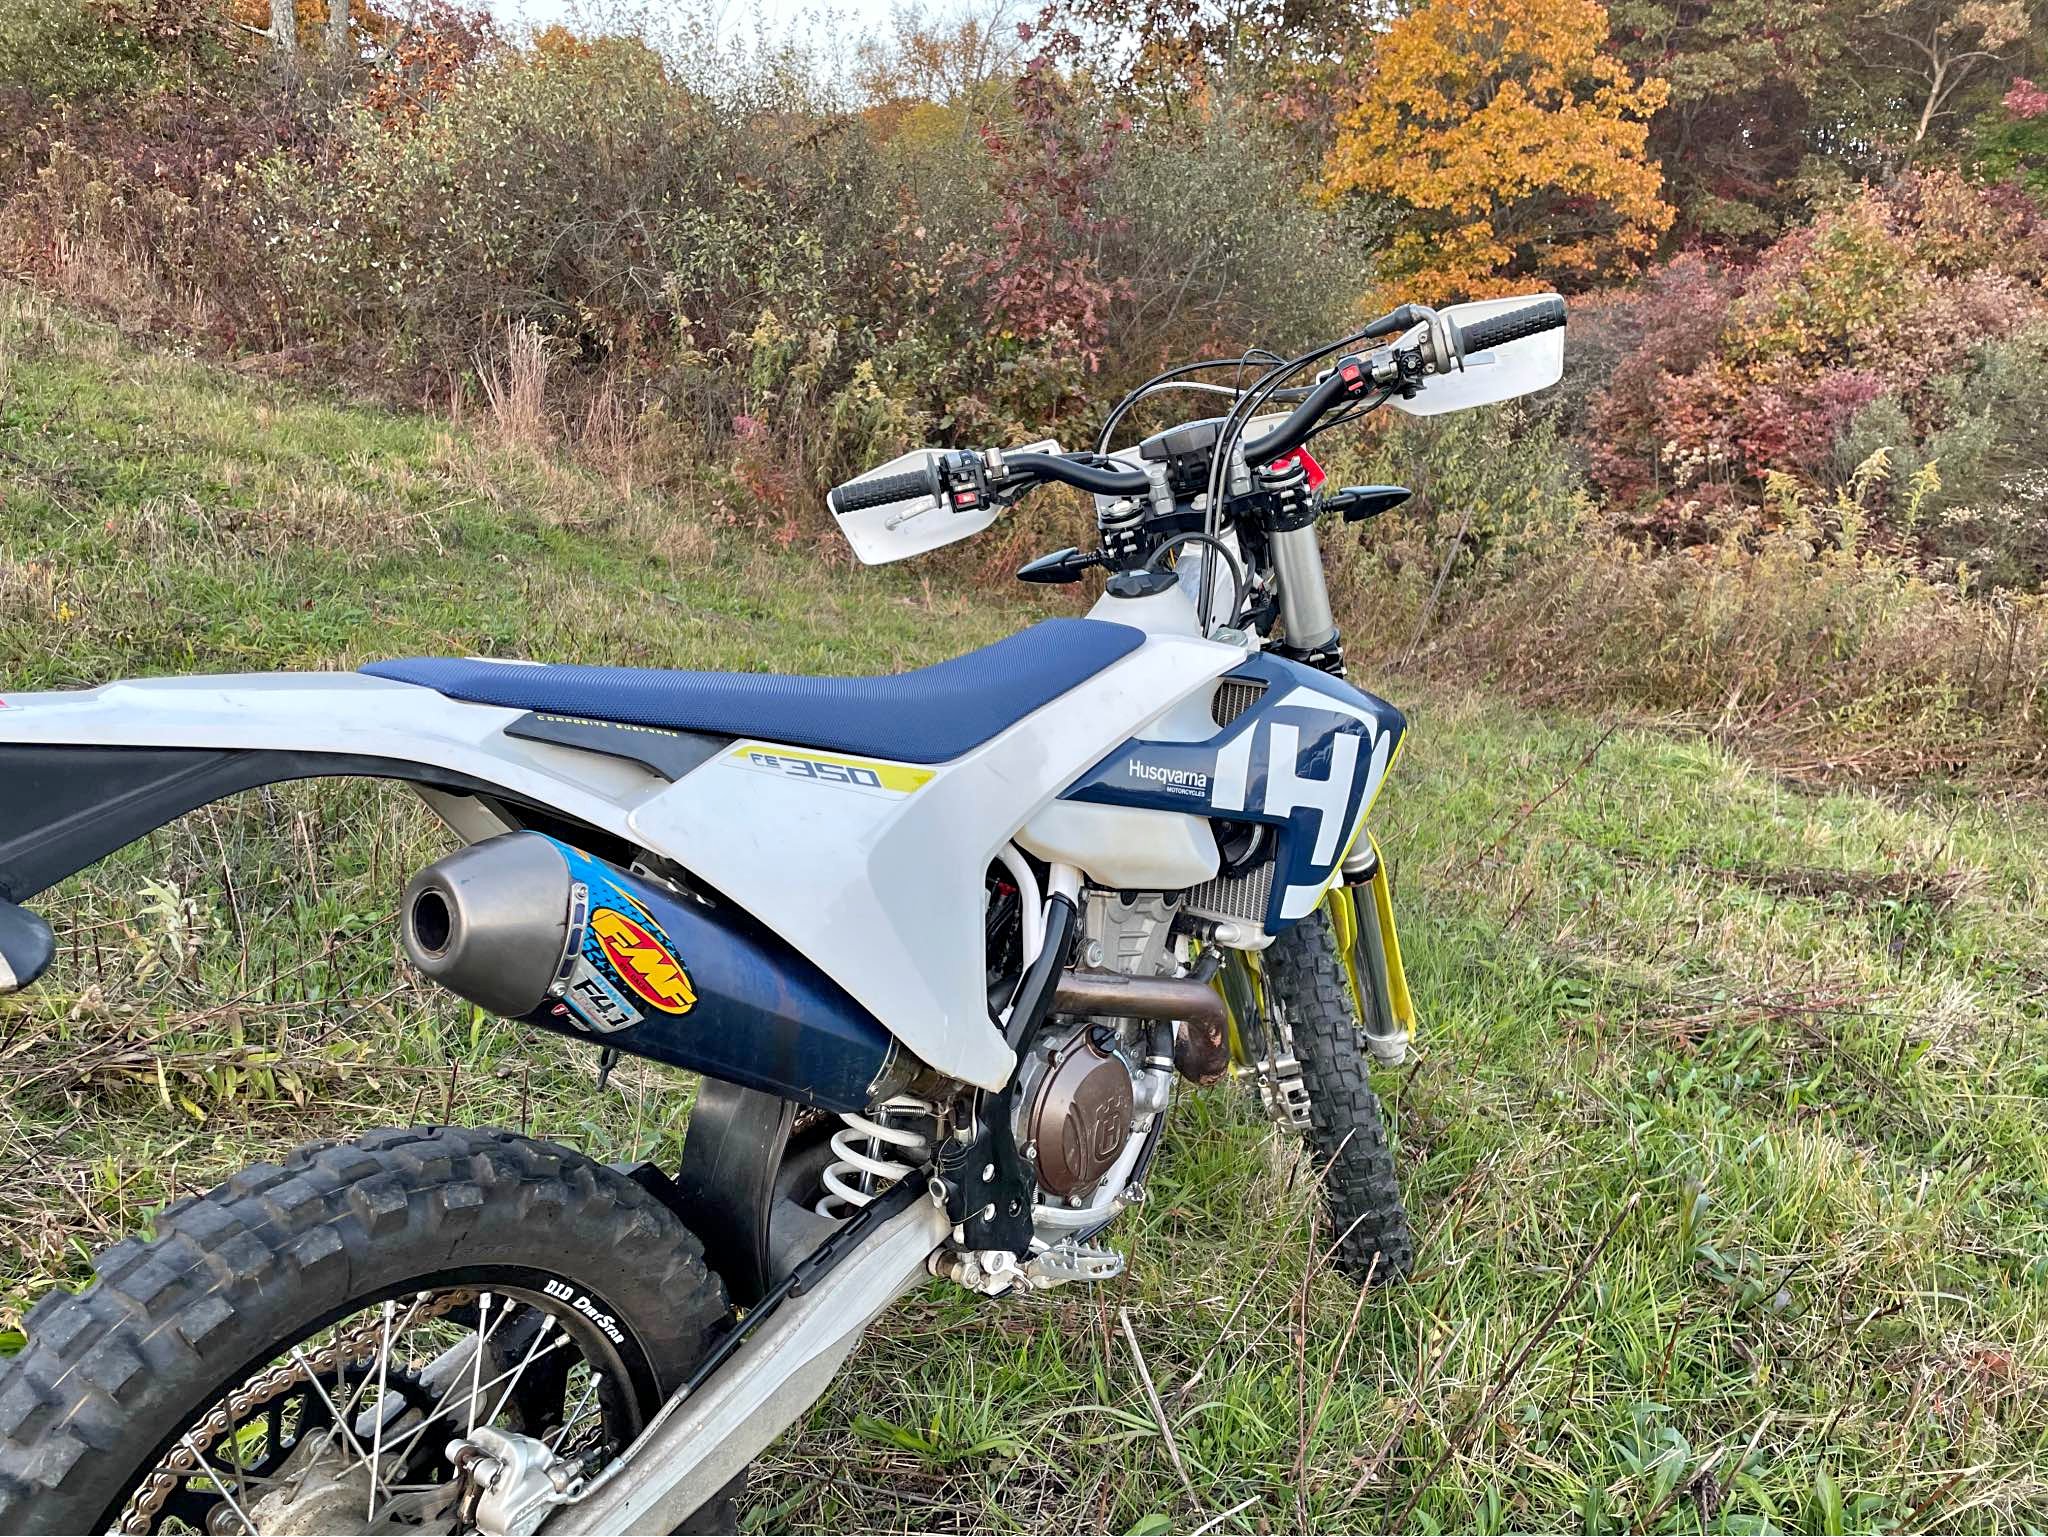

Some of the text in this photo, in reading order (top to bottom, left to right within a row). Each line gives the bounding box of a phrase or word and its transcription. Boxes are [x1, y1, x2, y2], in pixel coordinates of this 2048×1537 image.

[536, 715, 680, 738] COMPOSITE SUBFRAME
[749, 753, 882, 788] FE 350
[1129, 759, 1207, 788] Husqvarna
[1166, 786, 1206, 798] MOTORCYCLES
[590, 913, 698, 1008] FMF
[573, 978, 630, 1027] F4.1
